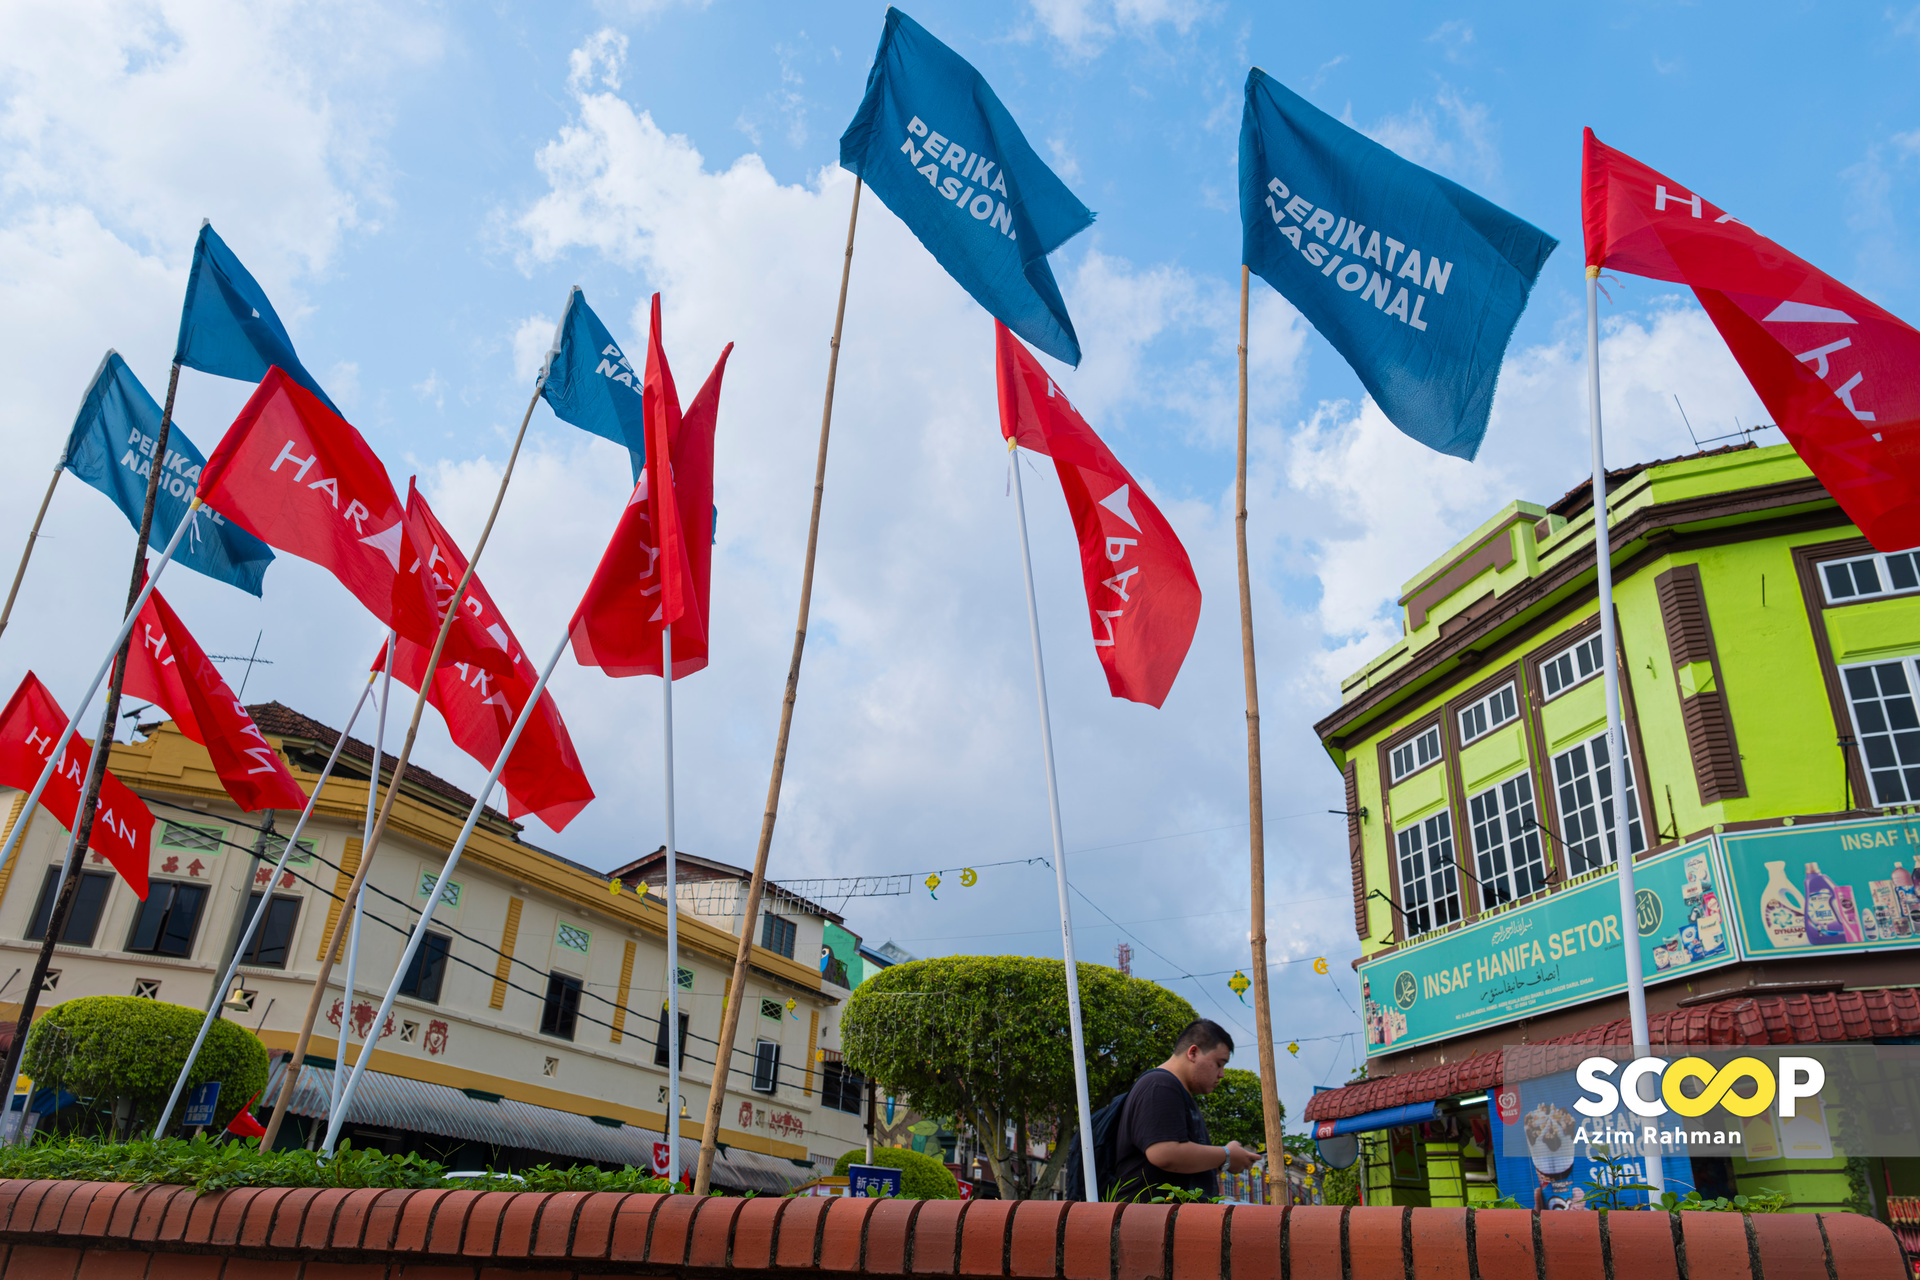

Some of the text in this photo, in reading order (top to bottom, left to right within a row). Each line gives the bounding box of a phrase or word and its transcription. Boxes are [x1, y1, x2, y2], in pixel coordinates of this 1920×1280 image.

[900, 137, 1017, 241] NASION
[906, 115, 1008, 198] PERIKA
[1264, 194, 1428, 332] NASIONAL
[1267, 176, 1454, 295] PERIKATAN
[1841, 829, 1898, 851] INSAF
[1423, 914, 1621, 1000] INSAF HANIFA SETOR
